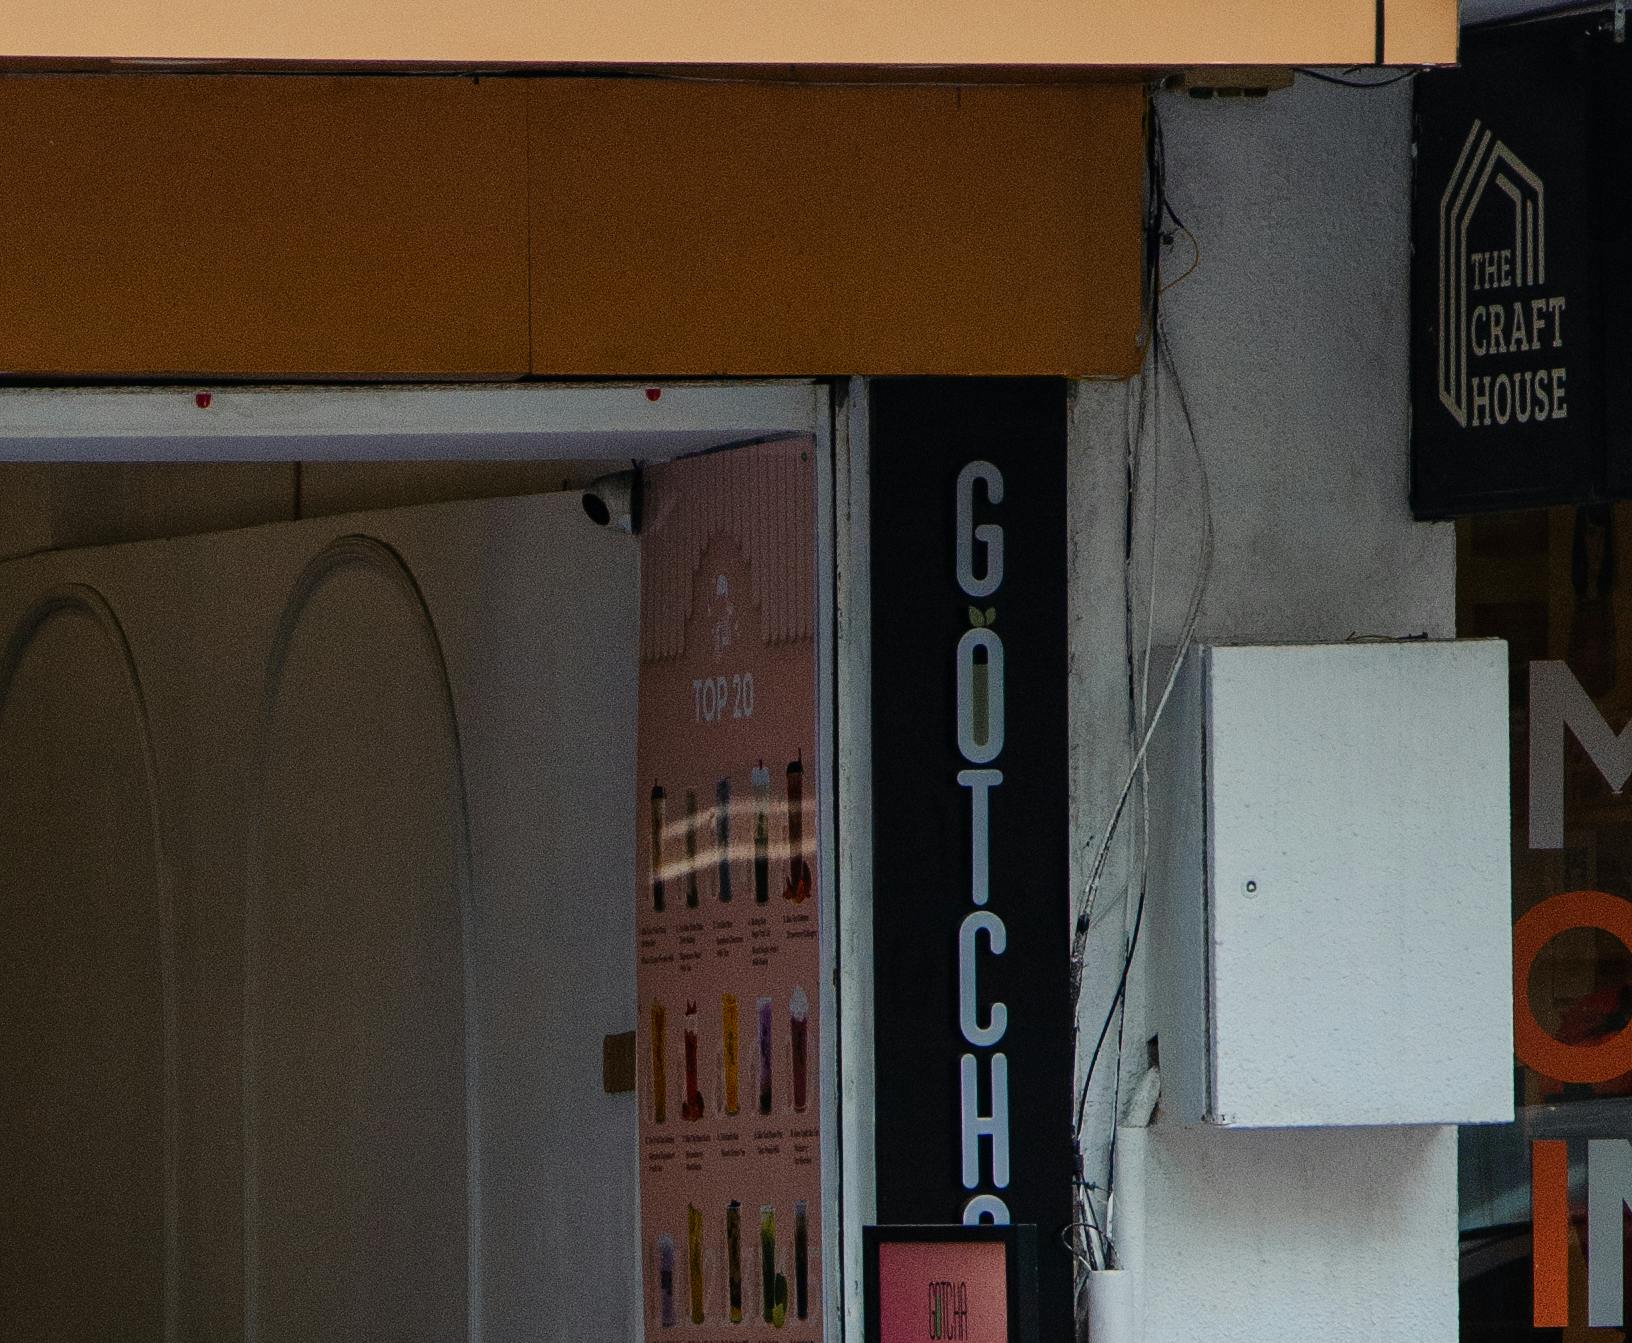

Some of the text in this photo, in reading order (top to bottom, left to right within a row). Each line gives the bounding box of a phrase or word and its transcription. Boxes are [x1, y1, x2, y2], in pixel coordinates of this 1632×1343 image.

[1471, 248, 1512, 290] THE
[1471, 297, 1566, 357] CRAFT
[1471, 368, 1567, 427] HOUSE
[692, 671, 755, 723] TOP 20
[956, 459, 1011, 1225] GOTCH
[928, 1281, 968, 1341] GOTCHA
